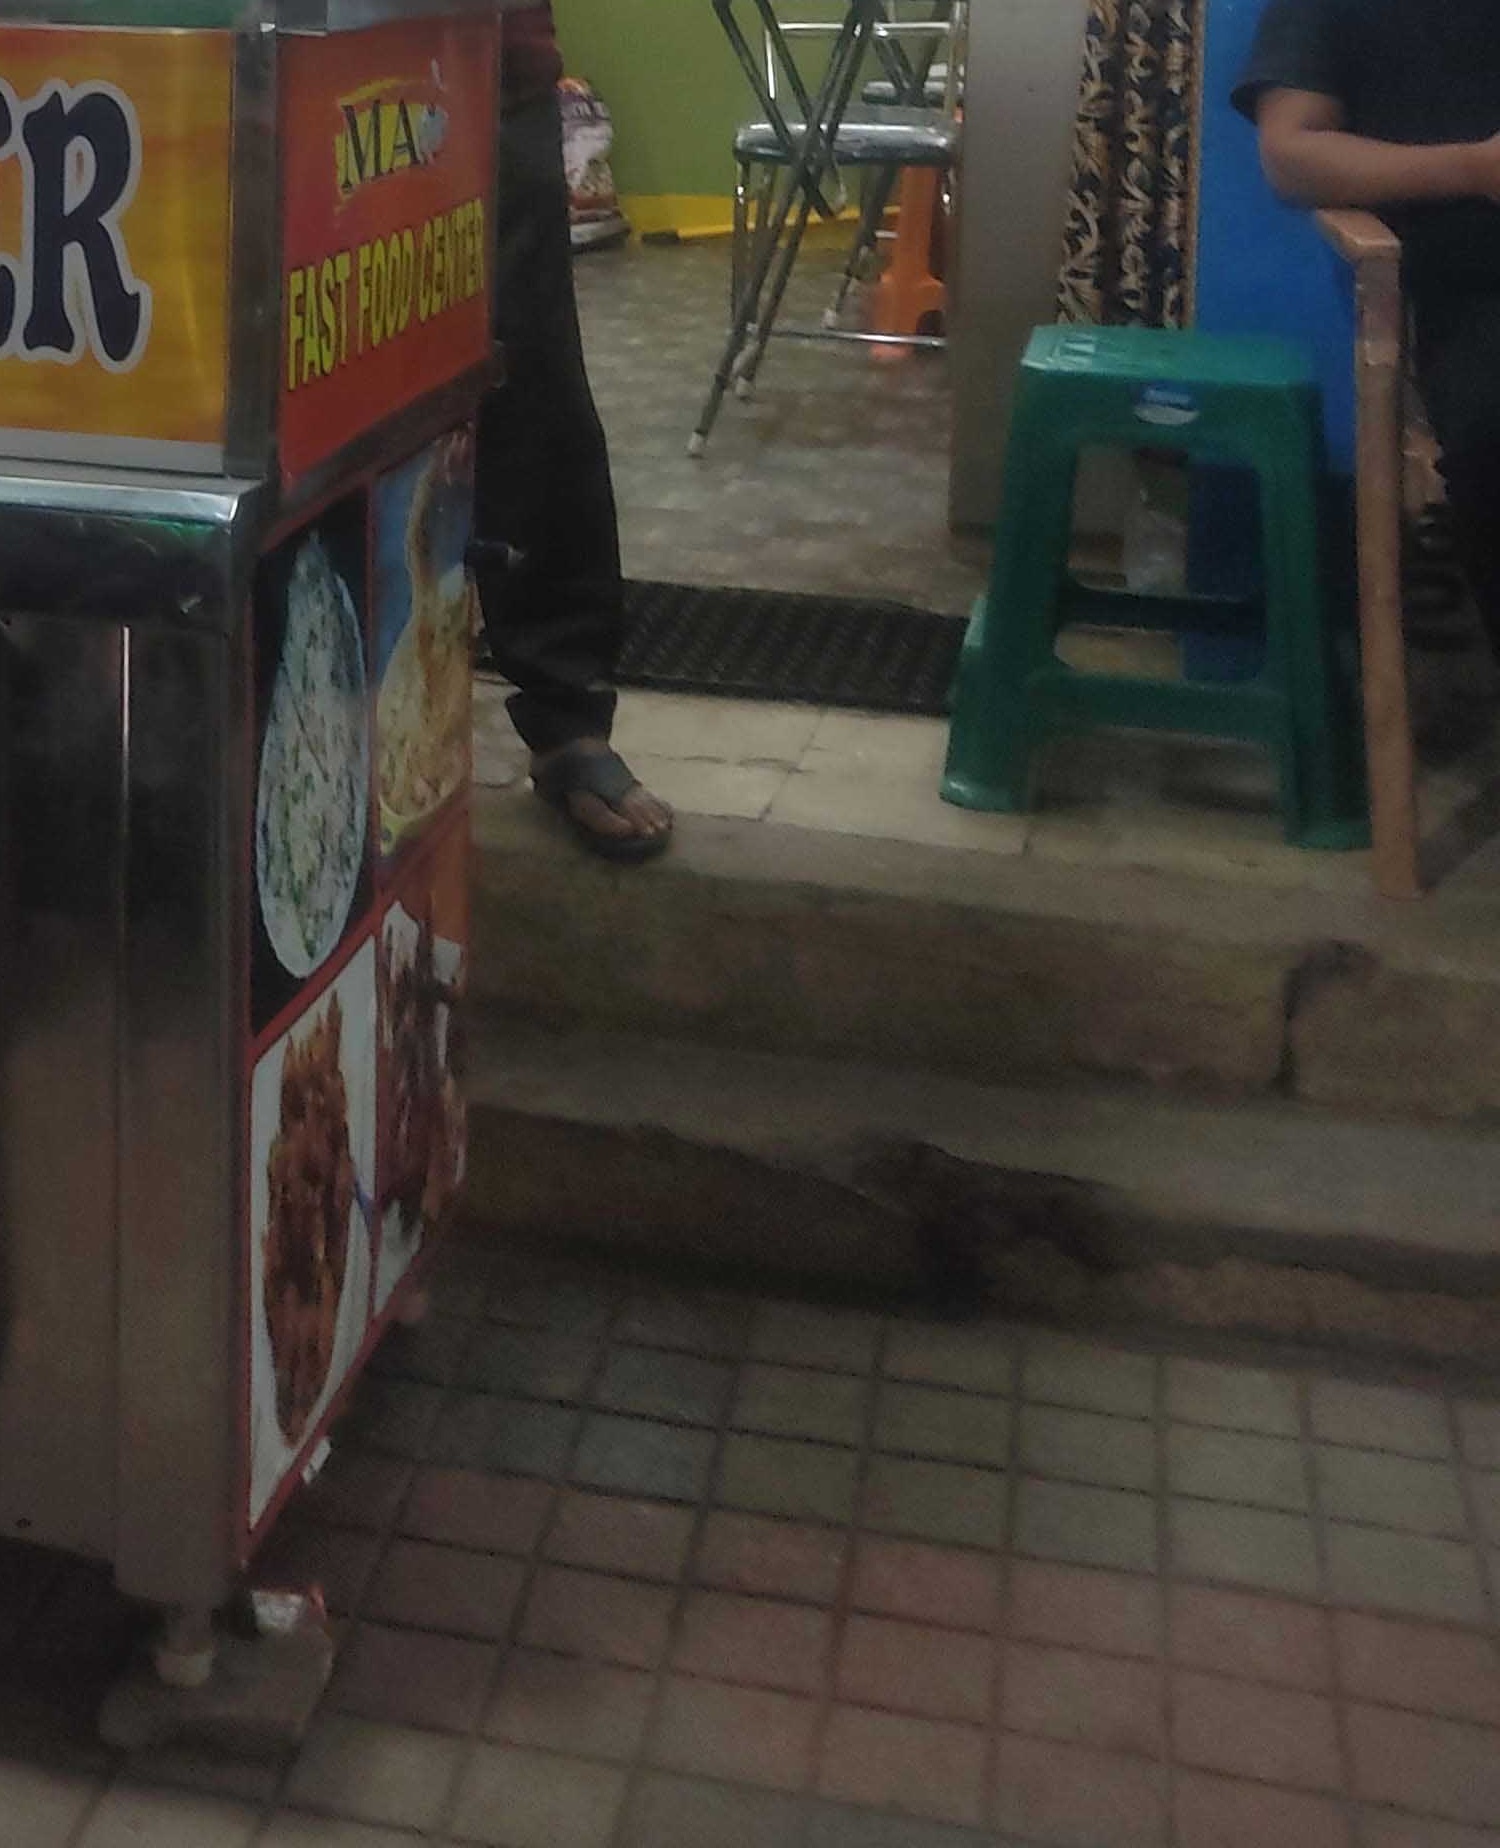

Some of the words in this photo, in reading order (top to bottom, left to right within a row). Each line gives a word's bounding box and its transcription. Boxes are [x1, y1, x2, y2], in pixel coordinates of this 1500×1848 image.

[341, 100, 421, 190] MA
[288, 252, 350, 390] FAST
[359, 230, 413, 355] FOOD
[419, 200, 485, 319] CENTER
